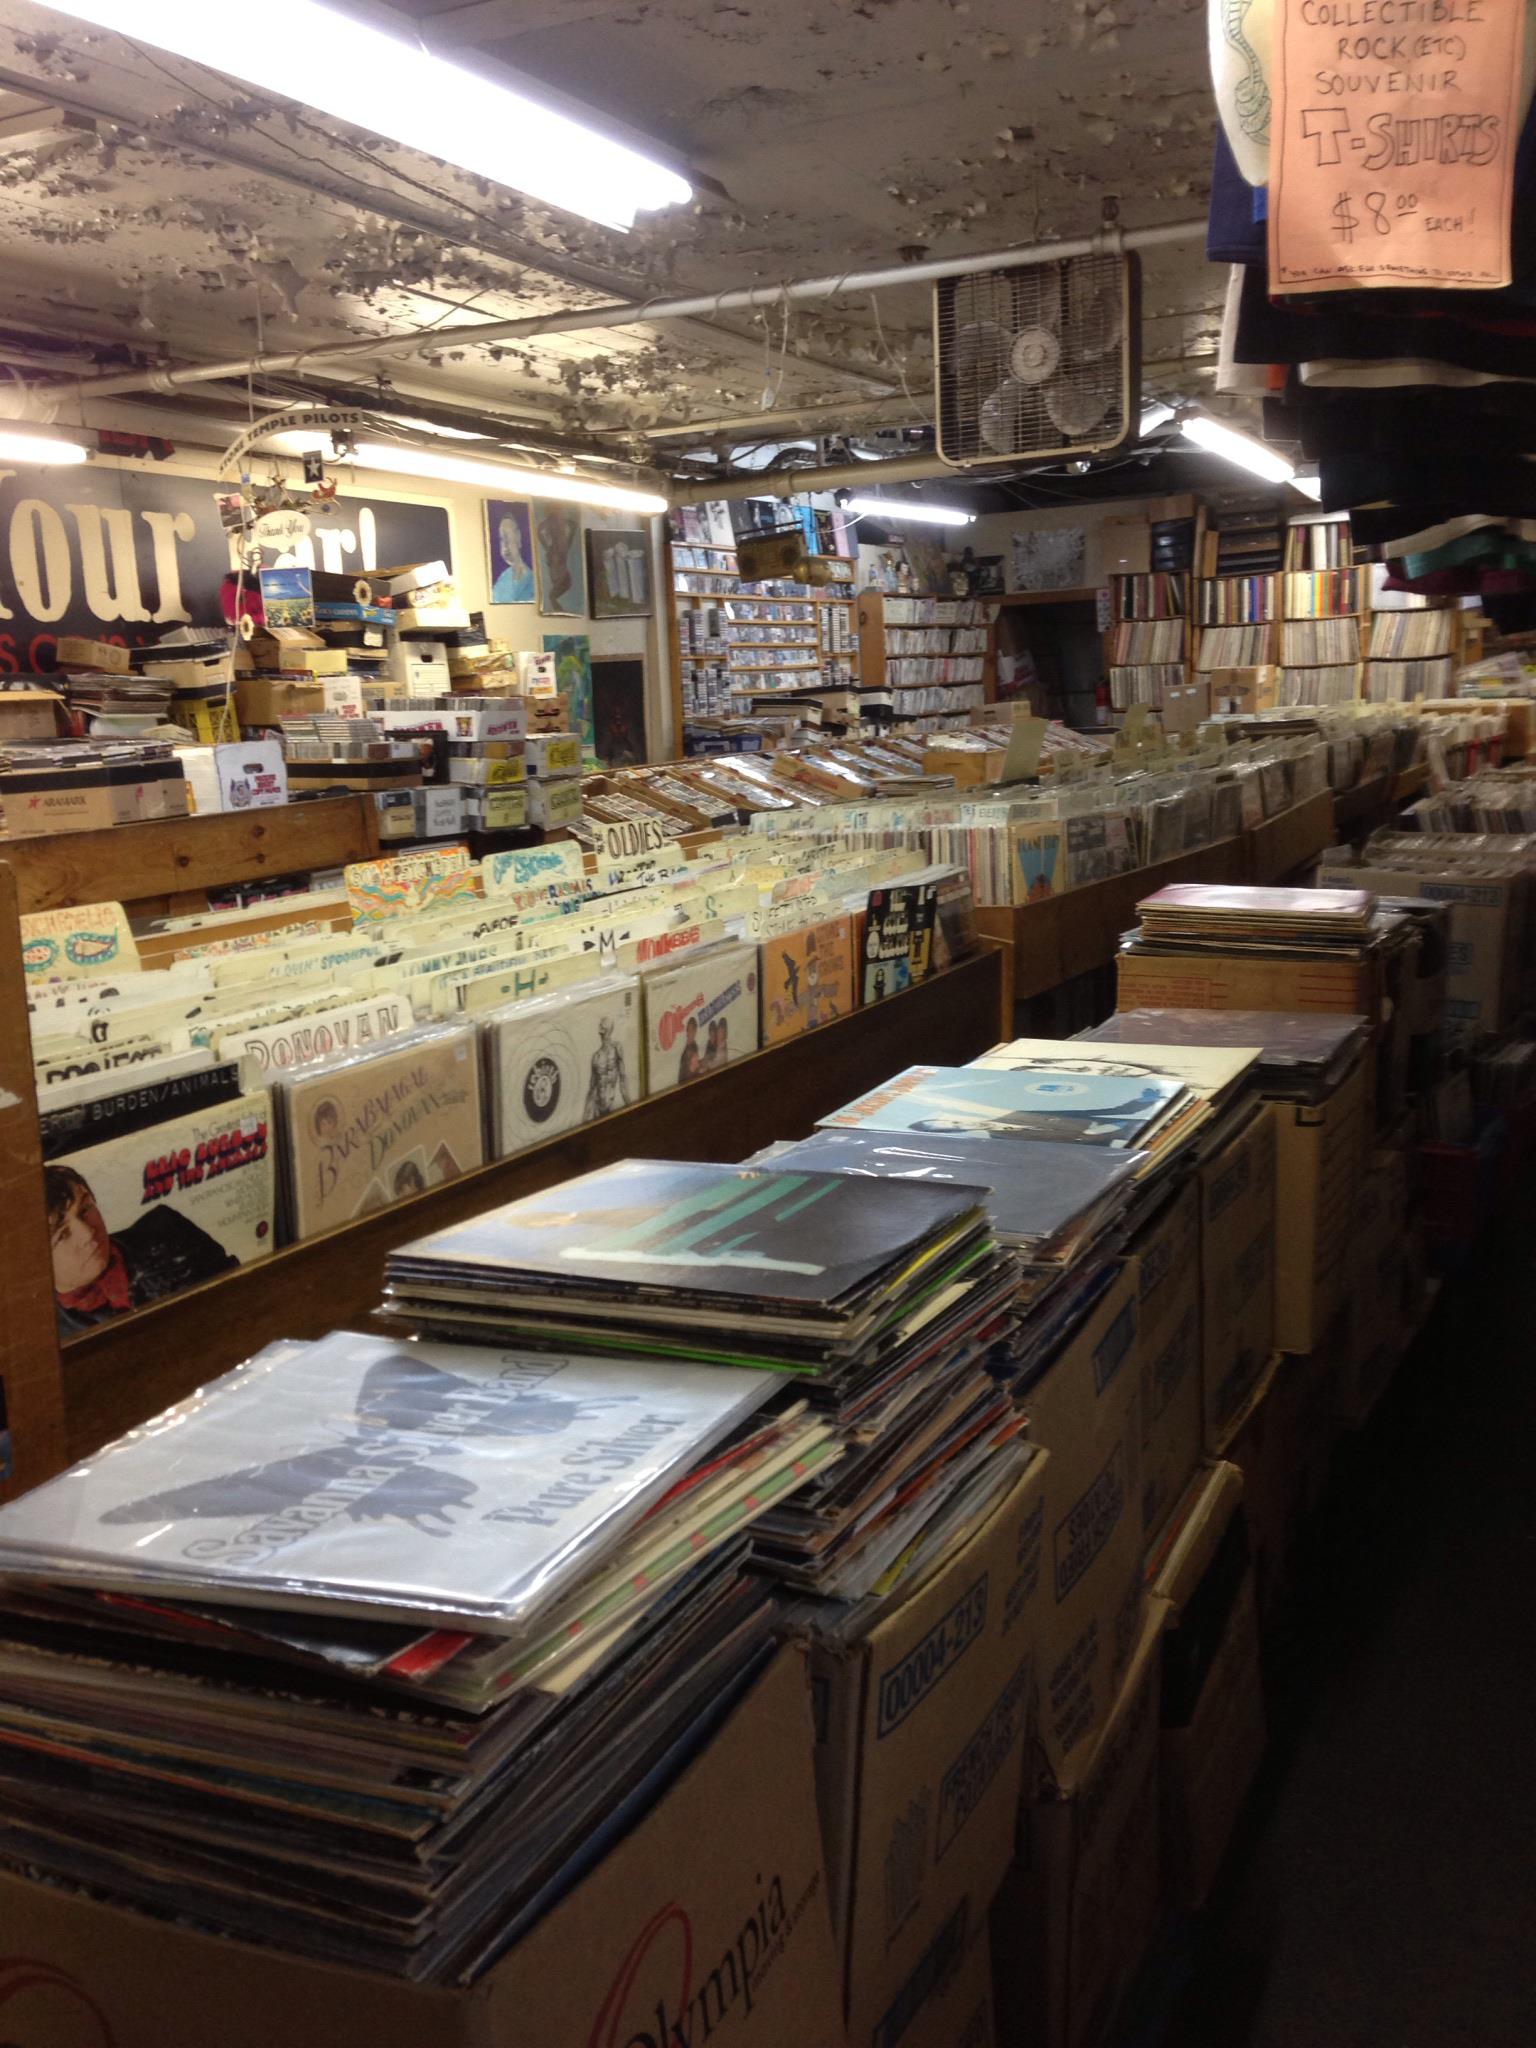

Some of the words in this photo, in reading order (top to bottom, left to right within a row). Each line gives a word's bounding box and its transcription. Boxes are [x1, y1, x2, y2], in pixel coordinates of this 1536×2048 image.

[1301, 0, 1485, 26] COLLECTIBLE
[1338, 36, 1405, 60] ROCK
[1413, 36, 1467, 61] (ETC)
[1315, 70, 1462, 95] SOUVENIR
[1301, 107, 1499, 170] T-SHIRTS
[1425, 207, 1477, 234] EACH!
[247, 415, 297, 442] TEMPLE
[302, 412, 360, 425] PILOTS
[606, 819, 663, 860] OLDIES
[244, 1004, 400, 1070] DONOVAN
[480, 1471, 612, 1528] Pure
[560, 1413, 687, 1471] Silver
[182, 1464, 406, 1568] Savanna
